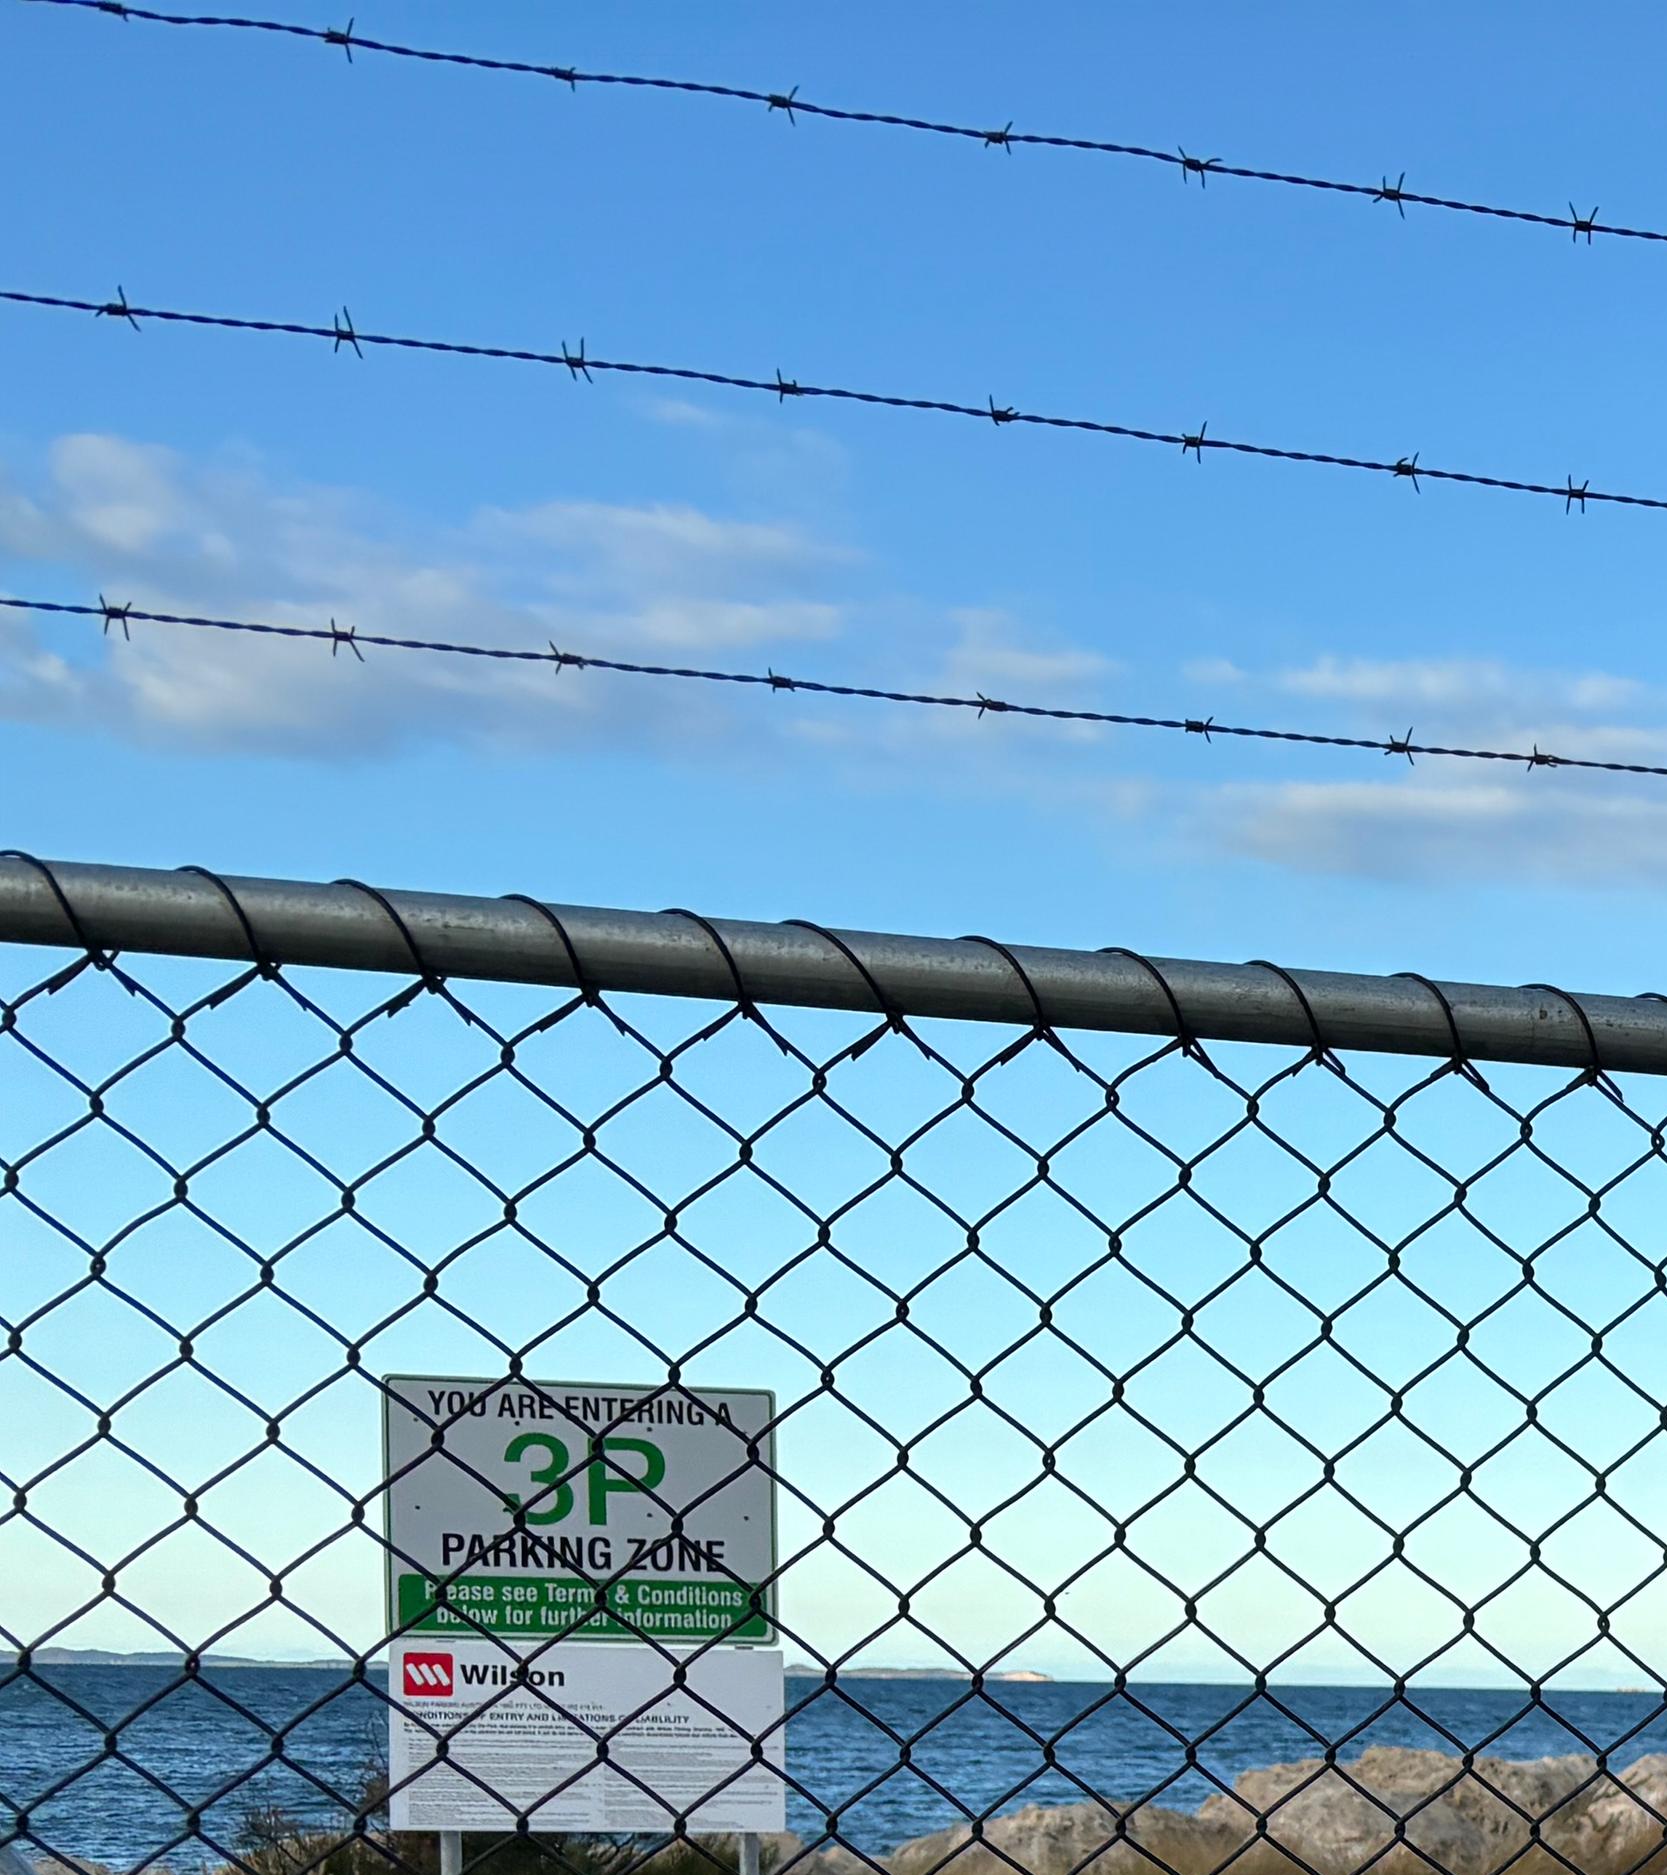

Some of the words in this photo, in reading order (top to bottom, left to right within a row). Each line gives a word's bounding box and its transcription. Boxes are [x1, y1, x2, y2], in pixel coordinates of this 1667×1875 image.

[428, 1390, 486, 1417] YOU
[498, 1393, 554, 1419] ARE
[565, 1396, 704, 1426] ENTERING
[711, 1402, 734, 1426] A
[503, 1432, 666, 1527] 3P
[442, 1533, 612, 1570] PARKING
[626, 1539, 725, 1573] ZONE
[425, 1581, 495, 1601] Pease
[502, 1586, 538, 1602] see
[545, 1583, 604, 1604] Term
[615, 1584, 630, 1605] &
[637, 1585, 743, 1607] Conditions
[505, 1605, 533, 1625] for
[617, 1608, 732, 1629] information
